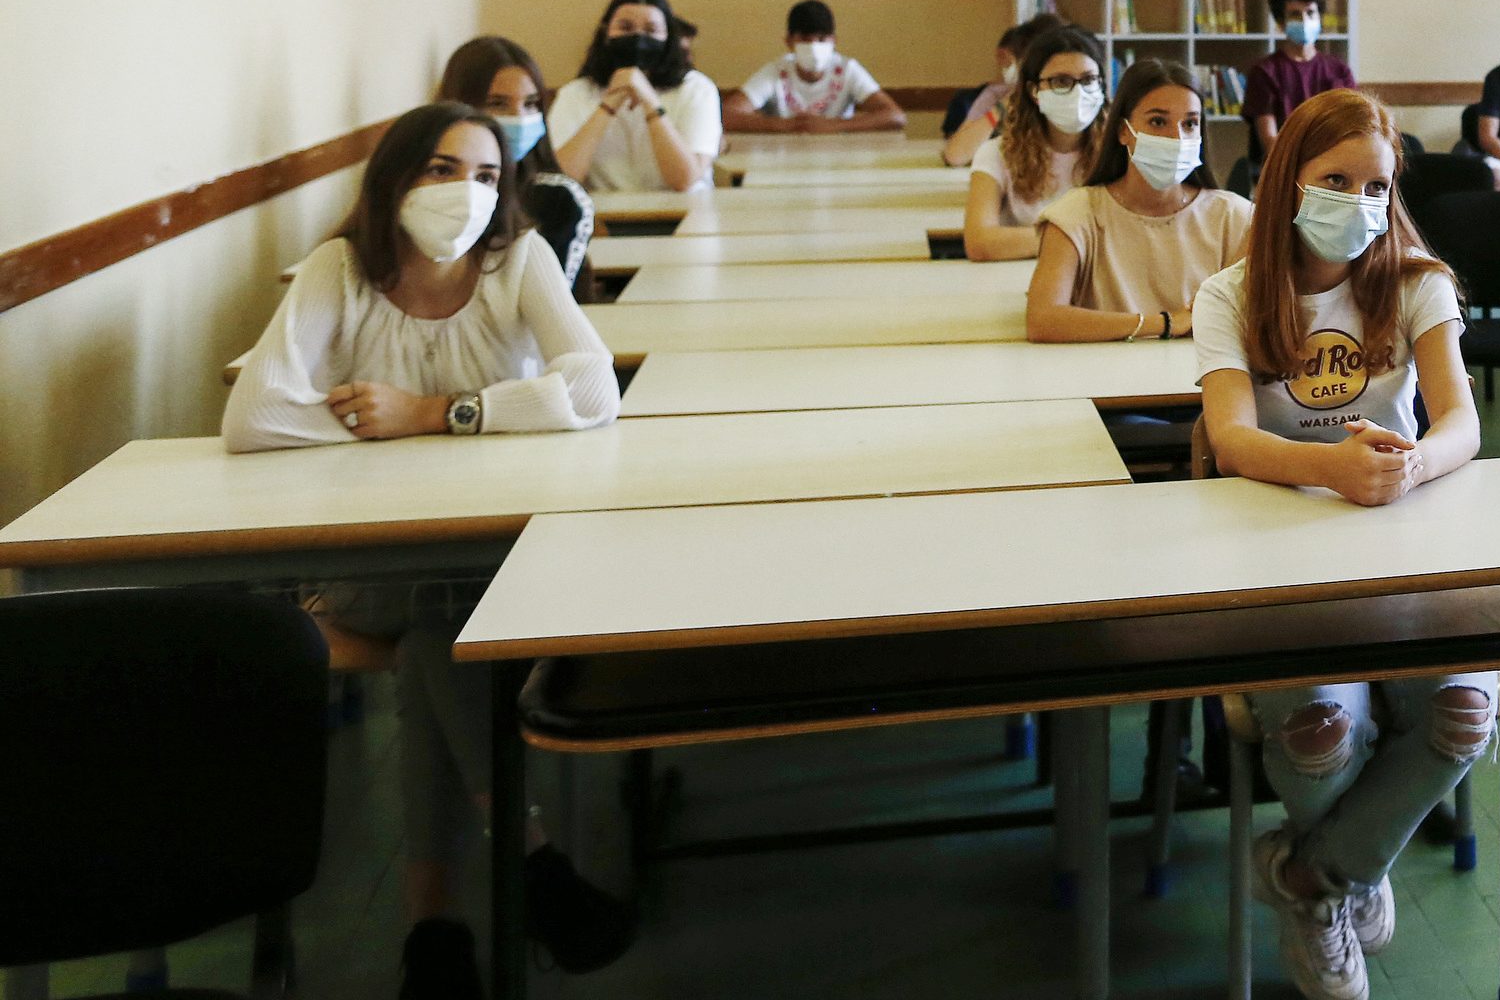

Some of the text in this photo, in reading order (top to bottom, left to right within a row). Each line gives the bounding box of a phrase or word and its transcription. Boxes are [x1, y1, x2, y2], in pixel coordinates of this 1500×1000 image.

[1328, 344, 1363, 378] Ro
[1311, 383, 1348, 399] CAFE
[1299, 413, 1361, 428] WARSAW
